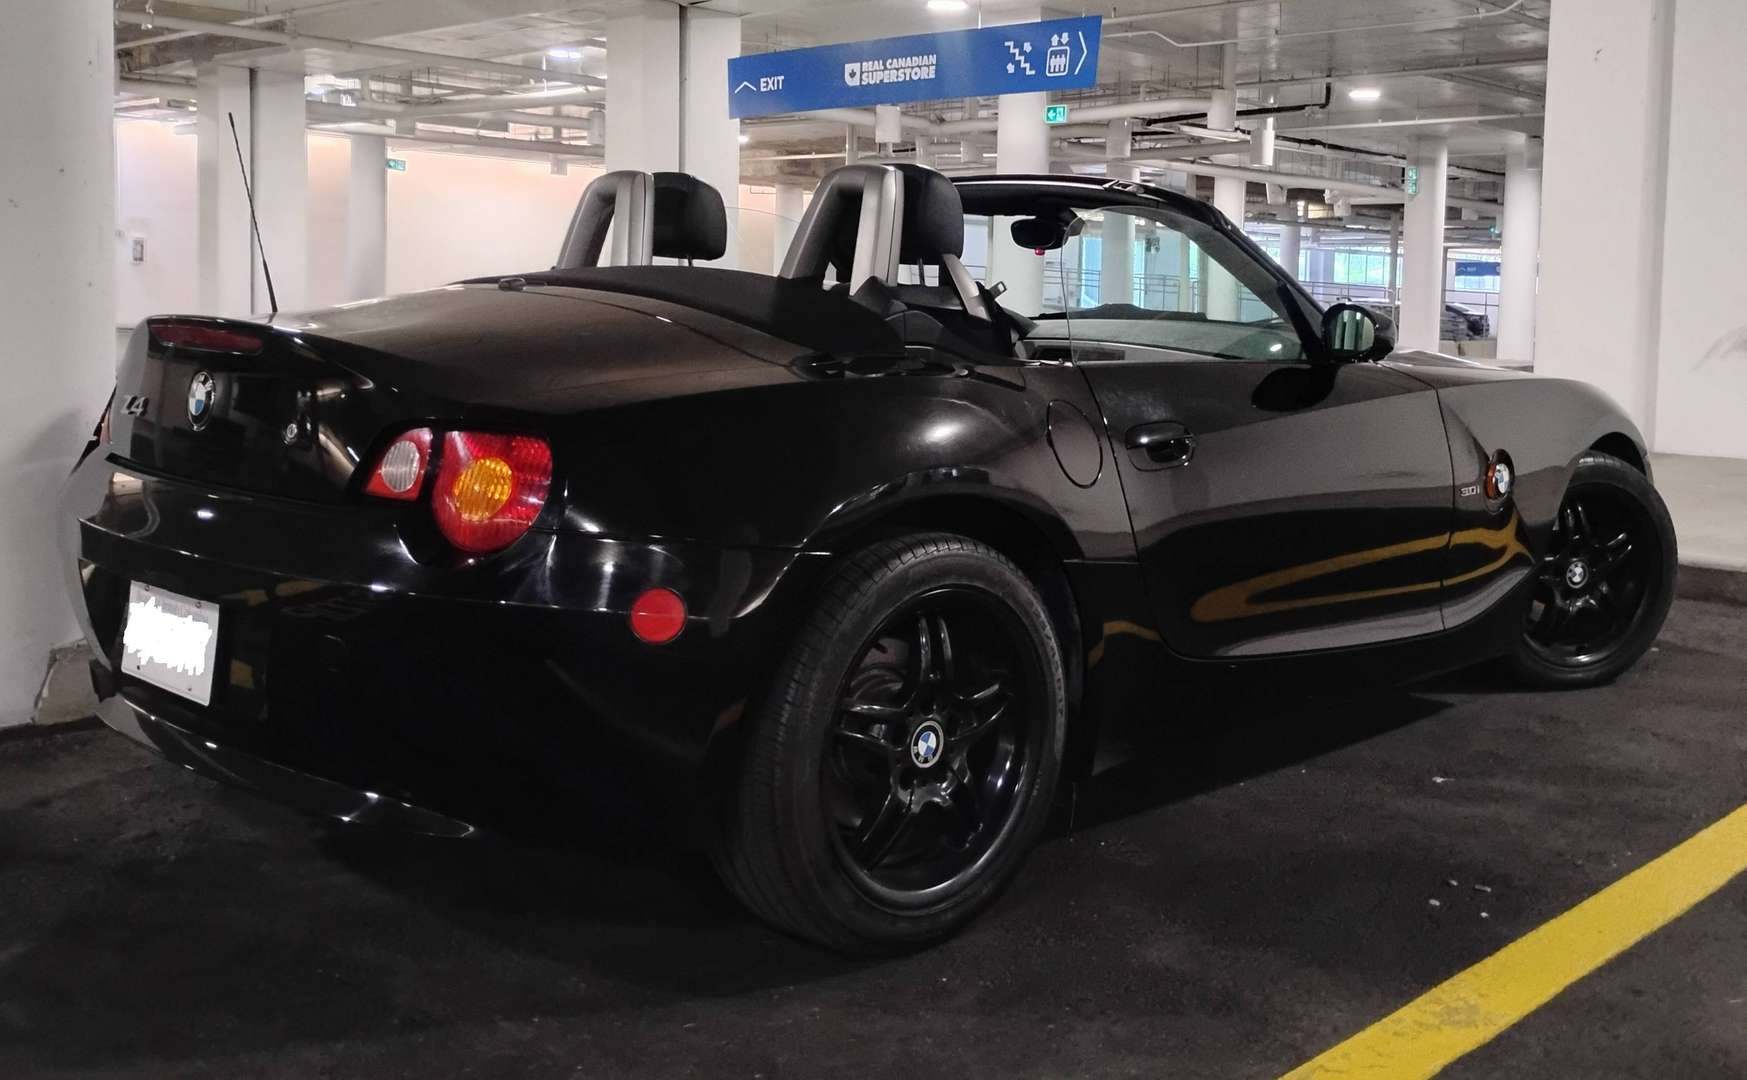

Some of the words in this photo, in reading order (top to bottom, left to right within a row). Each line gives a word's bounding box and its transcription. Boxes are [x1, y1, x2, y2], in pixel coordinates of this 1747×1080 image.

[862, 60, 884, 72] REAL
[886, 54, 937, 69] CANADIAN
[760, 75, 785, 92] EXIT
[861, 65, 936, 86] SUPERSTORE
